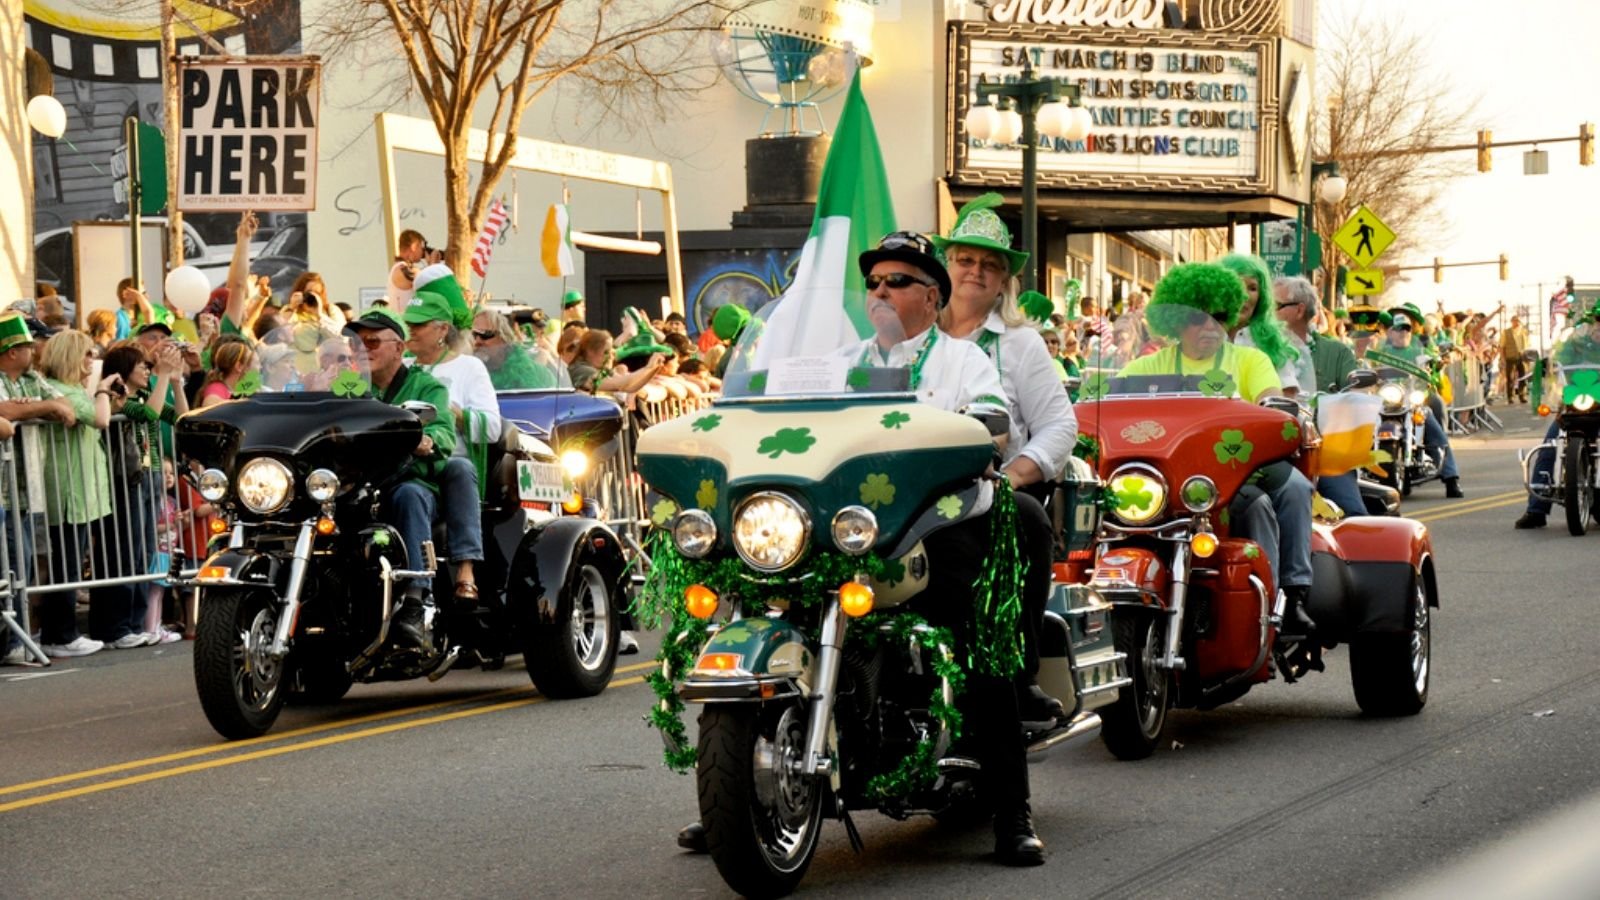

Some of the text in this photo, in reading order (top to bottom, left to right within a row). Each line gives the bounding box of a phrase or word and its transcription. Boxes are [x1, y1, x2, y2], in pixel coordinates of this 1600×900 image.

[1002, 46, 1044, 67] SAT
[1053, 48, 1127, 70] MARCH
[1134, 52, 1154, 73] 19
[1166, 53, 1225, 74] BLIND
[182, 68, 315, 128] PARK
[1129, 78, 1248, 102] SPONSORED
[1088, 106, 1258, 131] ANITIES COUNCIL
[1123, 134, 1179, 155] LIONS
[1184, 136, 1240, 157] CLUB
[184, 135, 307, 194] HERE
